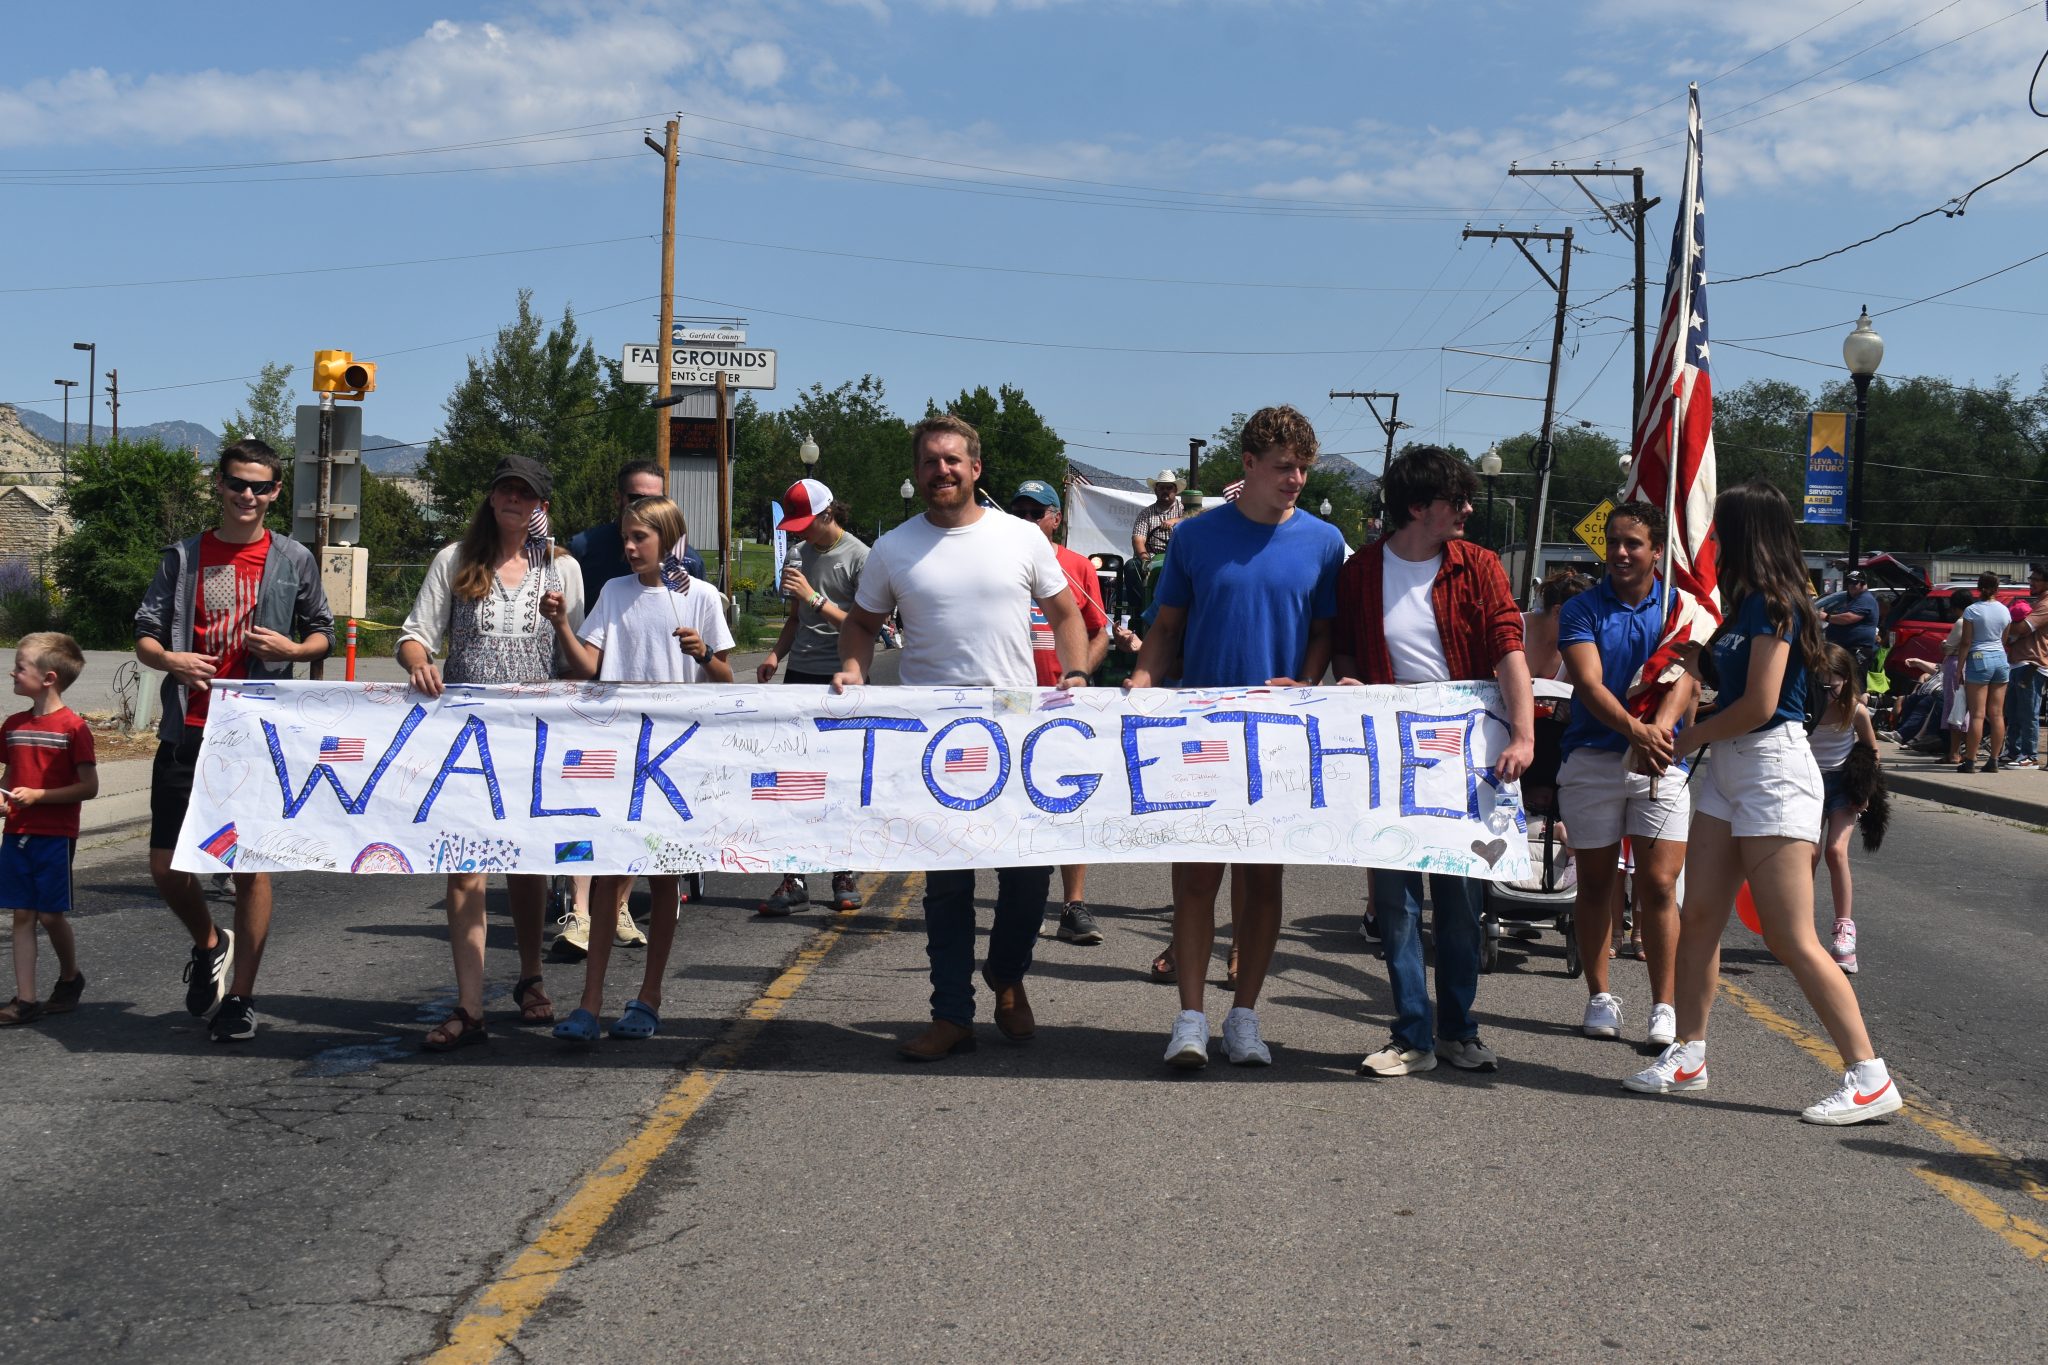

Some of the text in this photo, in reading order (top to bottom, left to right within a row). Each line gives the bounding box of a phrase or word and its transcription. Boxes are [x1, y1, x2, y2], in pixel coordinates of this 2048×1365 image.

[689, 332, 741, 341] Garfield County
[632, 348, 767, 368] FAIGROUNDS
[671, 371, 740, 383] ENTS CETER
[1591, 537, 1605, 546] ZO
[259, 702, 701, 824] WALK
